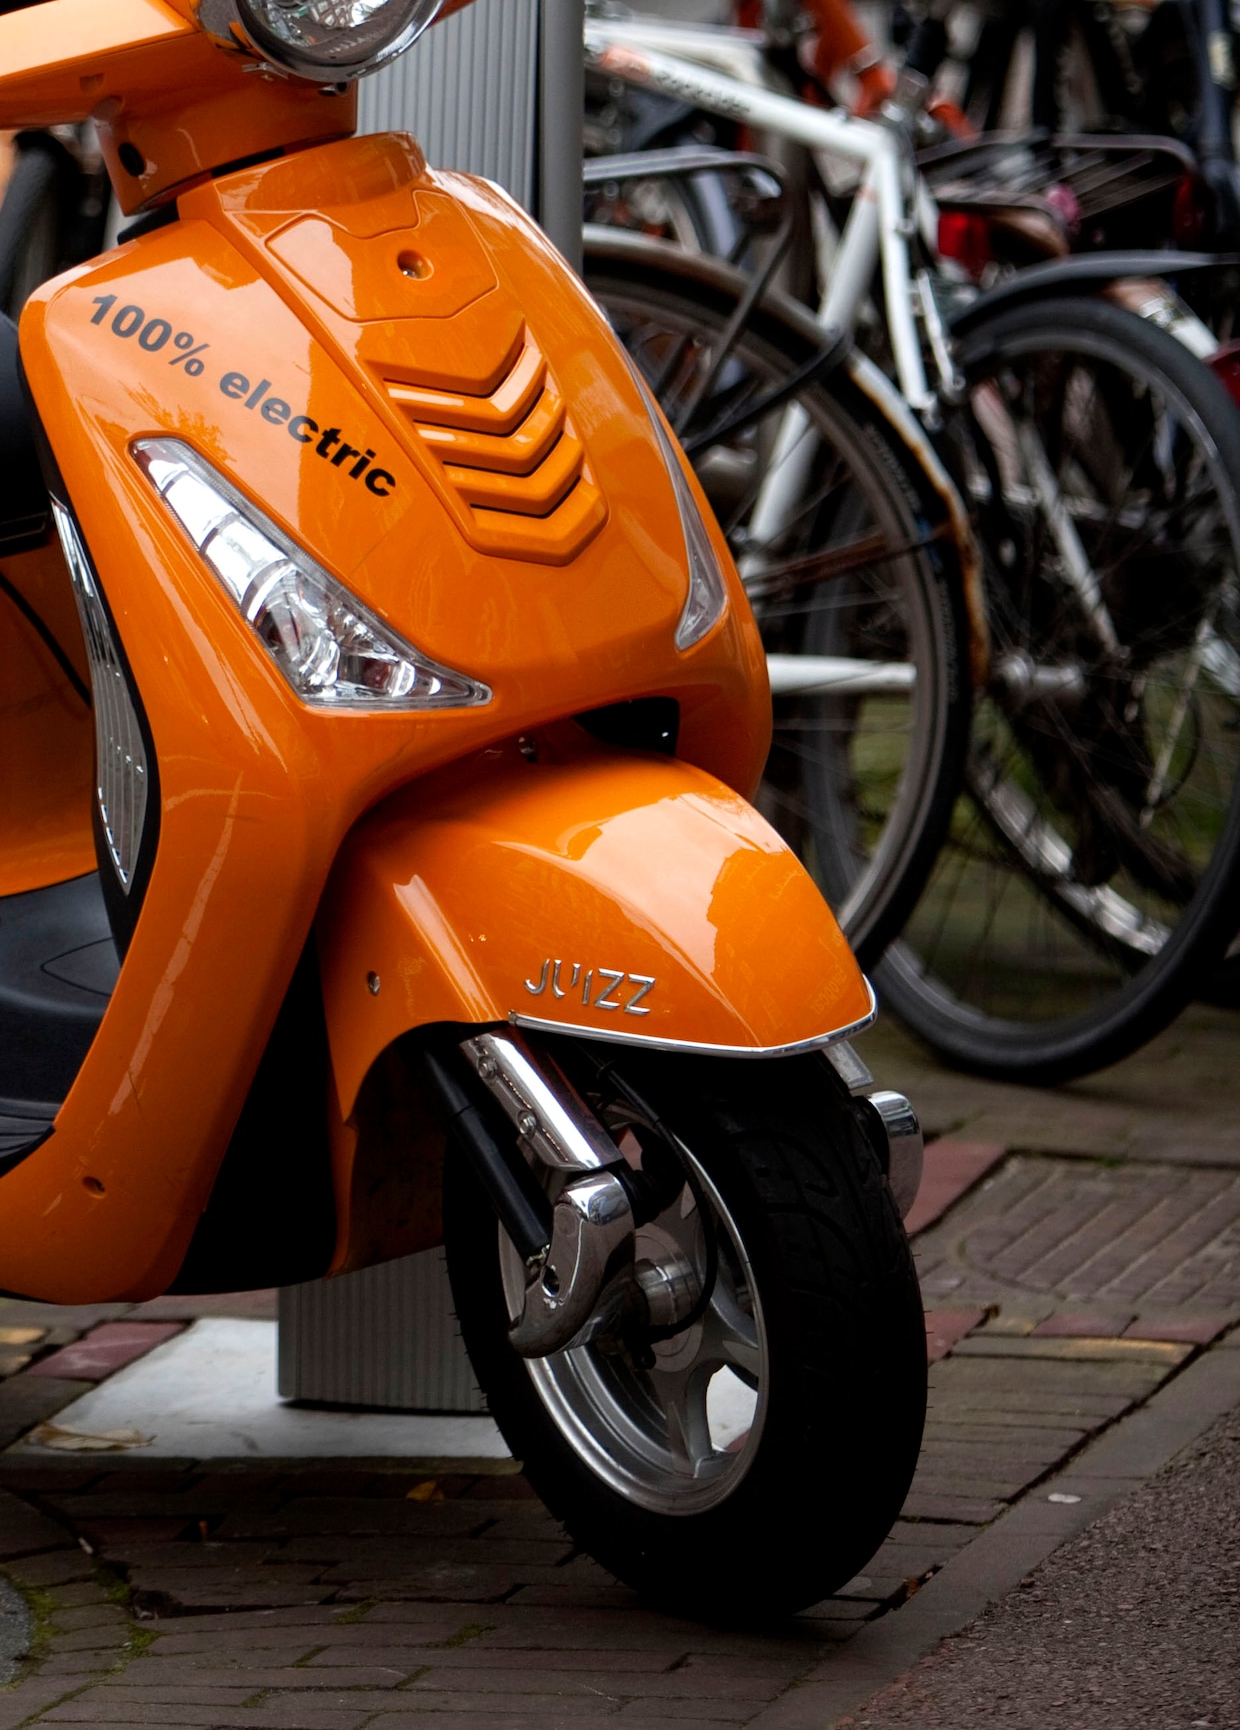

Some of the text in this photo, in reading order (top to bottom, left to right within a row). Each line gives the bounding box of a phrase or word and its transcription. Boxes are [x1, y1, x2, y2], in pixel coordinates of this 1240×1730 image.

[90, 293, 396, 497] 100% electric
[524, 958, 656, 1015] JUIZZ
